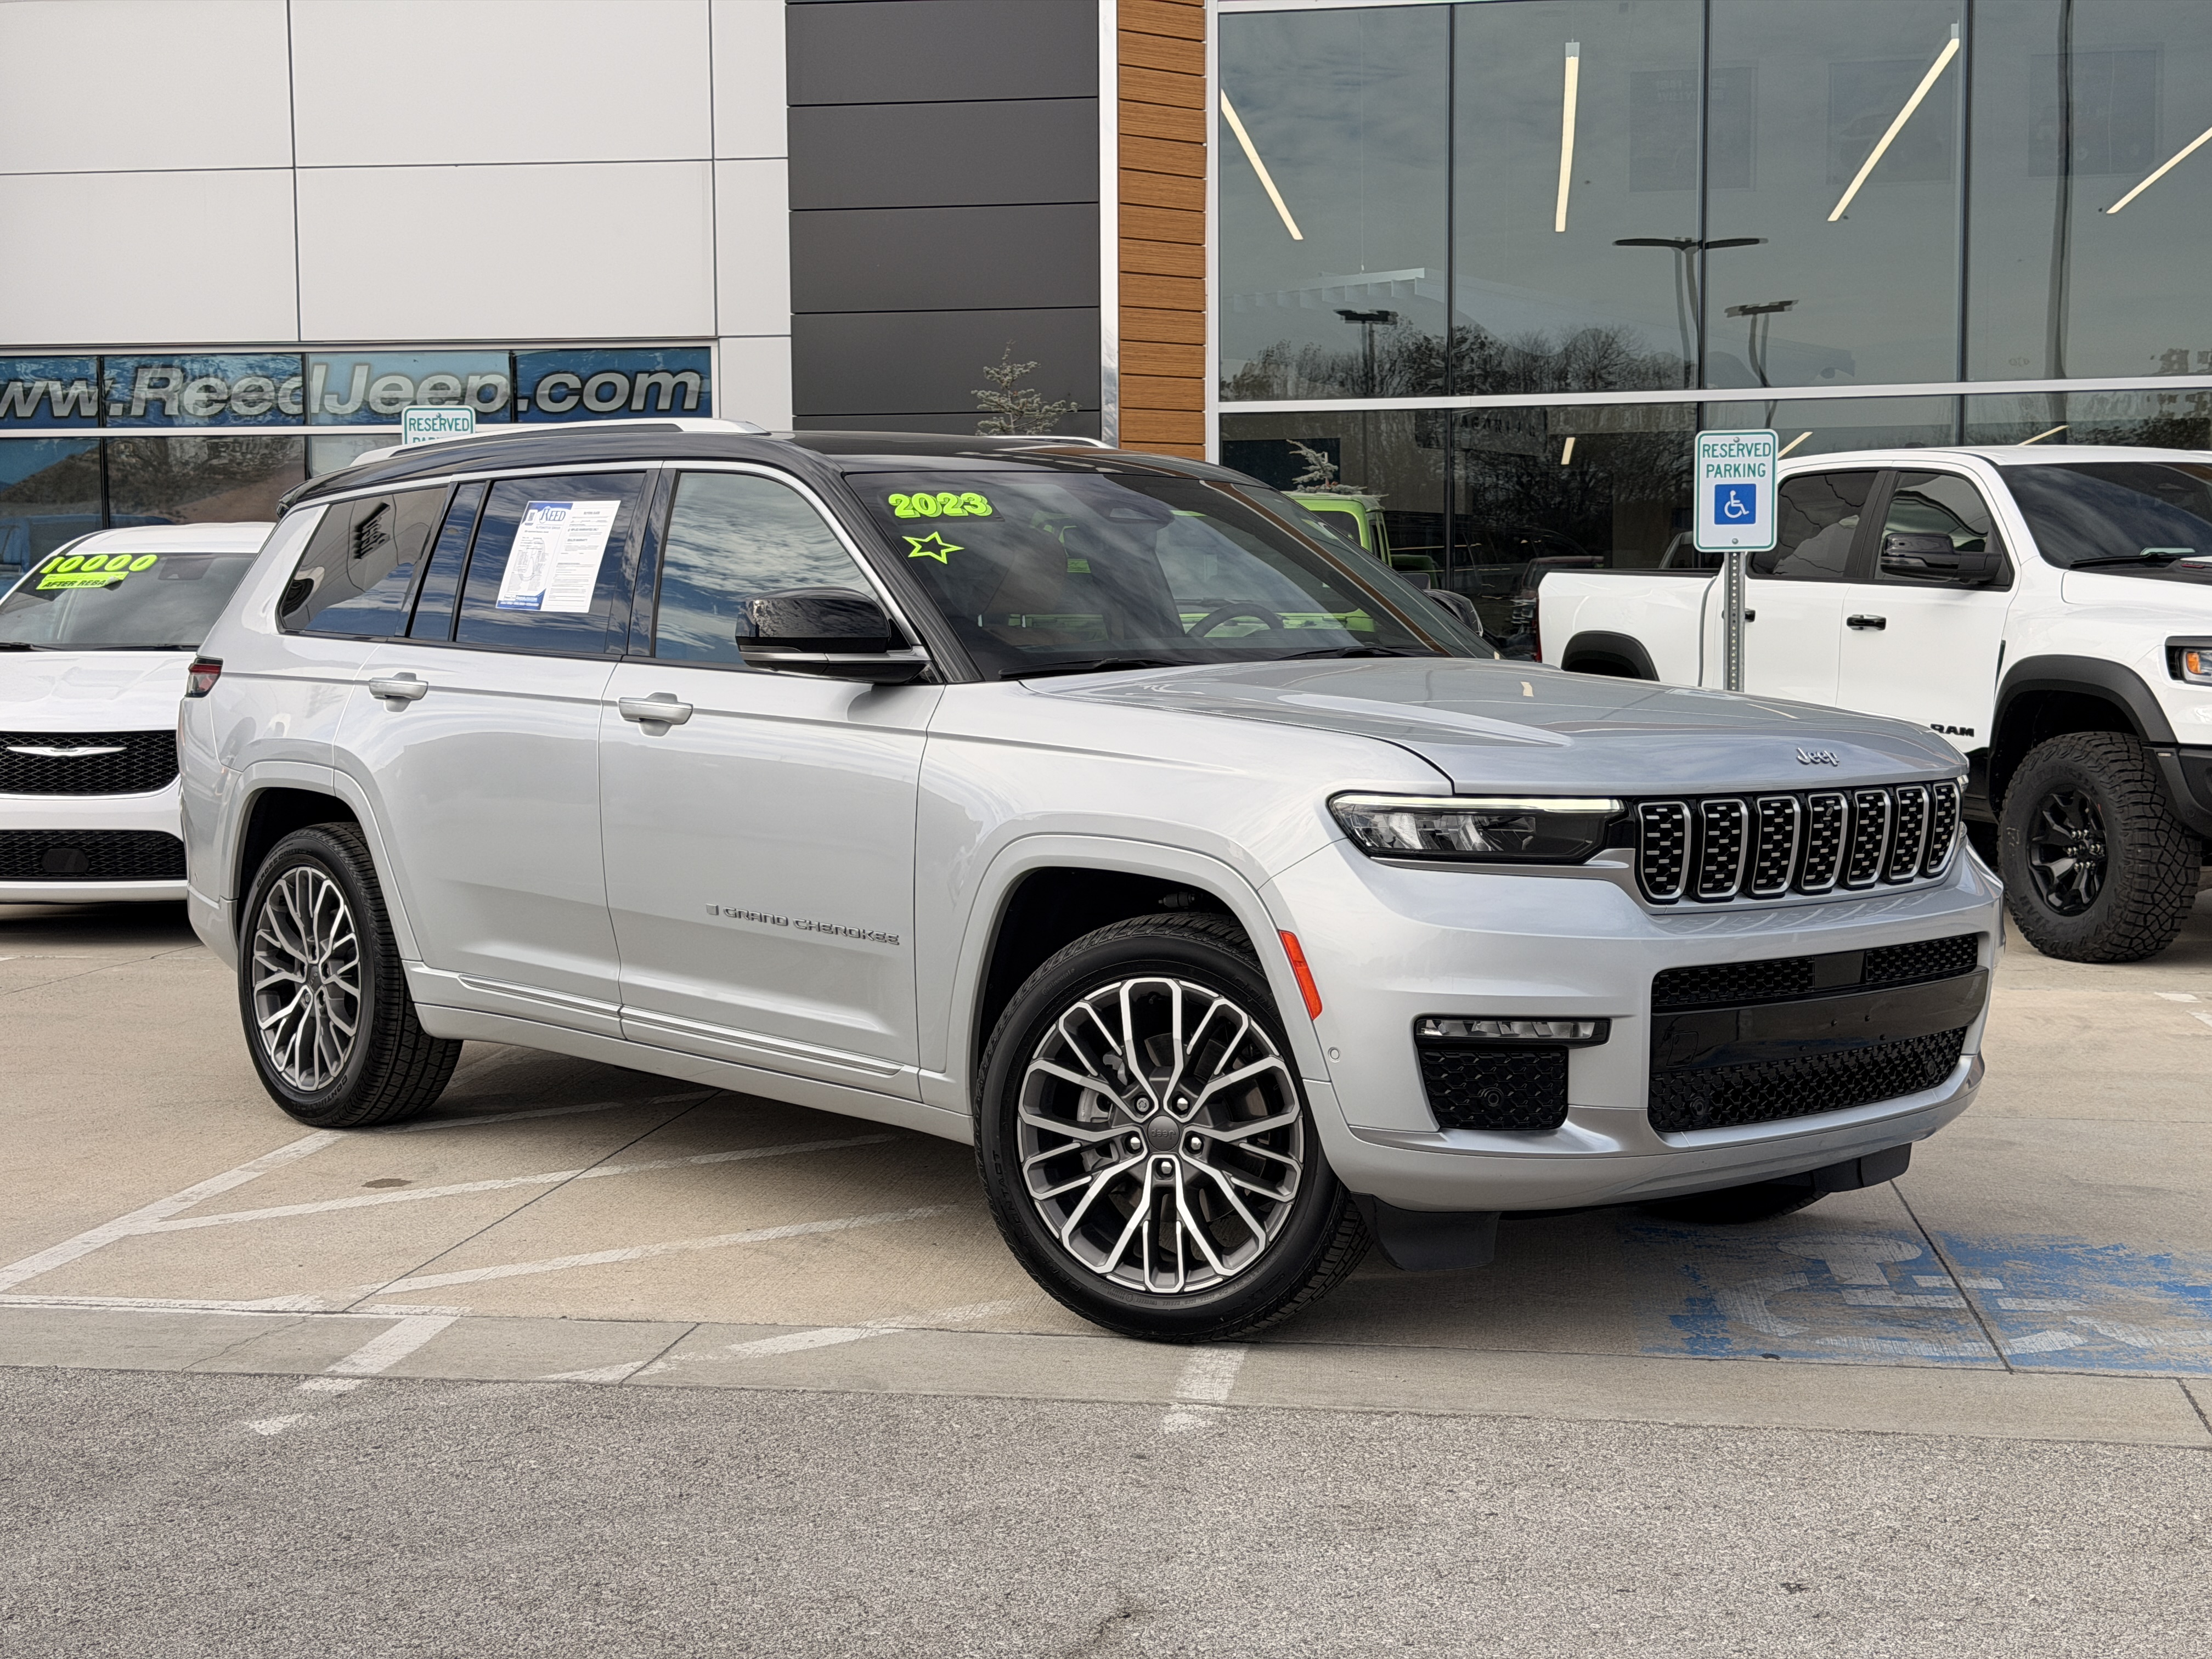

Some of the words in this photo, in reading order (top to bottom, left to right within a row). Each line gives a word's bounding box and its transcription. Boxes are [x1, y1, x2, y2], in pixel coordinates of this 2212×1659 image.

[409, 417, 470, 432] RESERVED
[1702, 442, 1771, 458] RESERVED
[1706, 463, 1766, 478] PARKING
[888, 493, 992, 518] 2023
[539, 508, 566, 523] REED
[40, 554, 158, 573] 10000
[1797, 747, 1840, 767] Jeep
[723, 906, 788, 926] GRAND
[793, 918, 900, 945] CHEROKEE
[1152, 1128, 1177, 1140] Jeep
